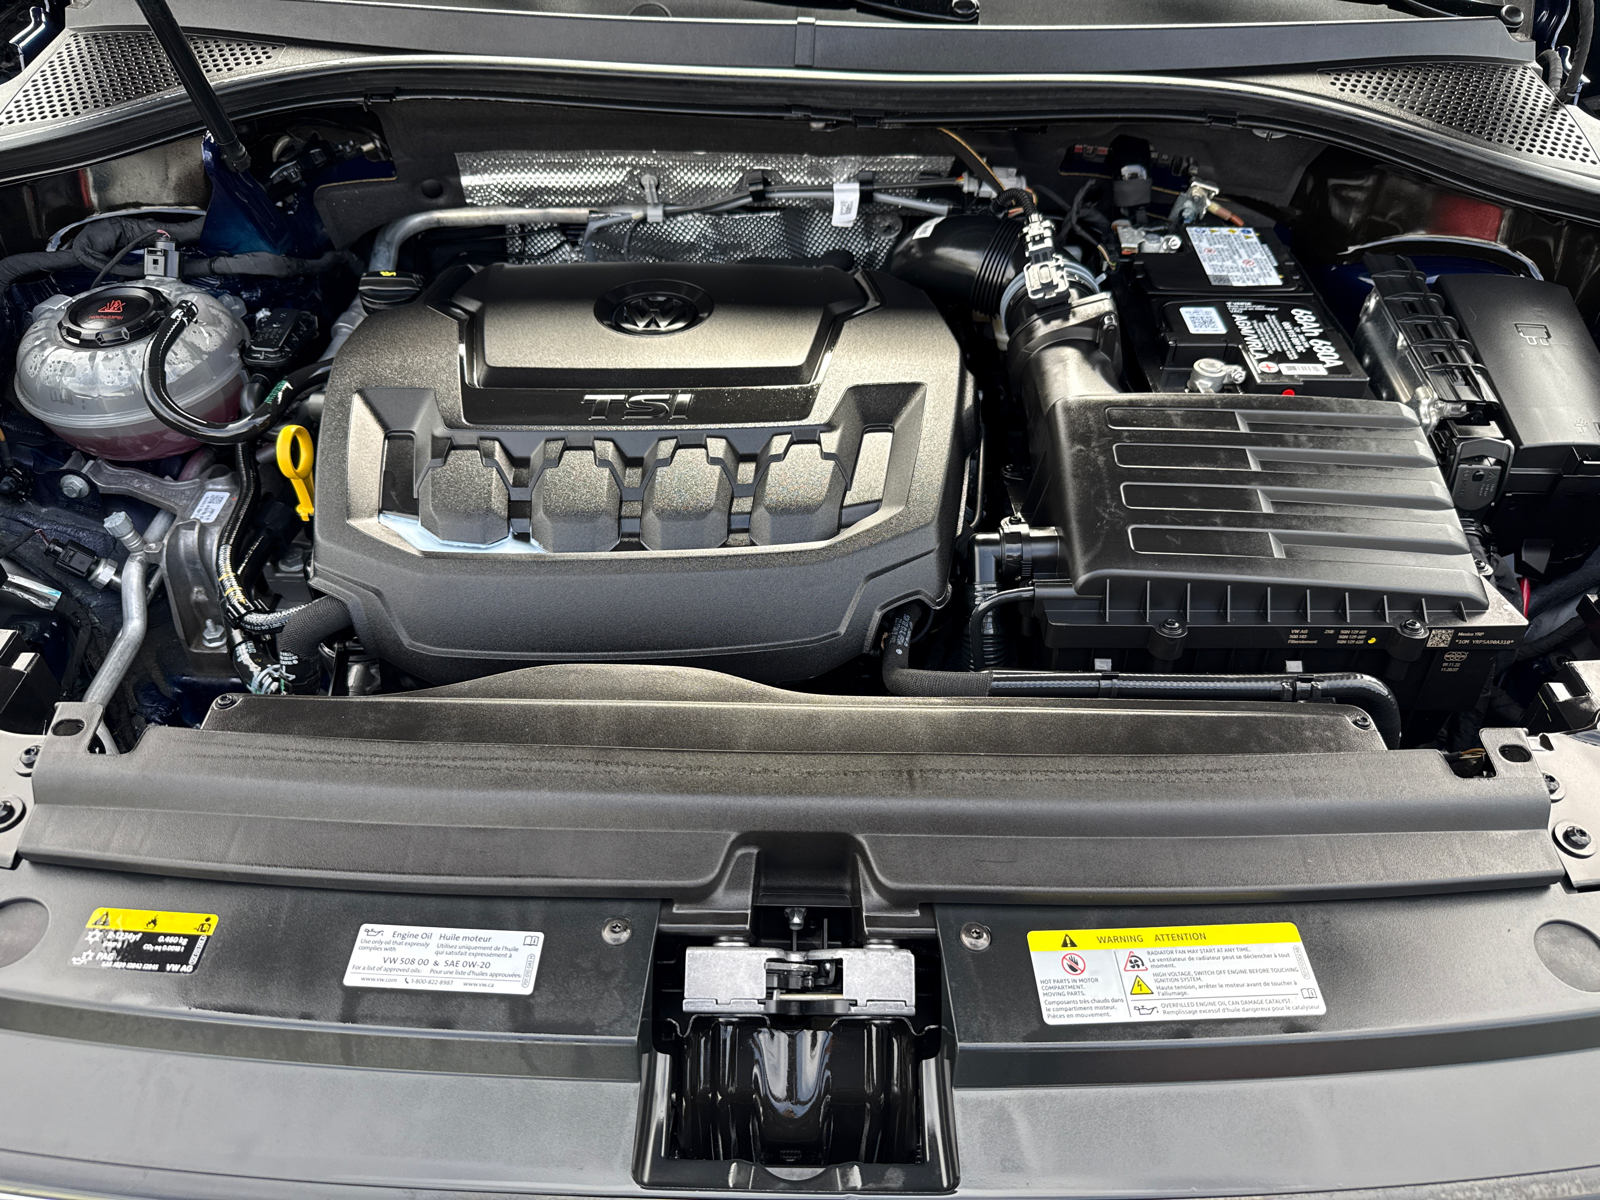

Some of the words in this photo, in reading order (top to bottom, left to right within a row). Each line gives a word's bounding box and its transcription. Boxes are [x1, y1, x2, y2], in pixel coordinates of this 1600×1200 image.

[1290, 308, 1324, 336] 68Ah
[1309, 338, 1344, 368] 680A
[580, 394, 694, 420] TSI
[158, 935, 179, 944] 0.460
[179, 936, 189, 946] kg
[392, 931, 419, 940] Engine
[421, 932, 433, 940] Oil
[439, 933, 460, 941] Huile
[1096, 935, 1144, 944] WARNING
[1154, 932, 1207, 942] ATTENTION
[96, 952, 115, 960] PAG
[166, 964, 180, 972] VW
[180, 964, 193, 972] AG
[400, 957, 416, 965] 508
[417, 958, 430, 966] 00
[444, 960, 460, 968] SAE
[462, 960, 491, 969] 0W-20
[411, 978, 453, 986] 1-800-822-8987
